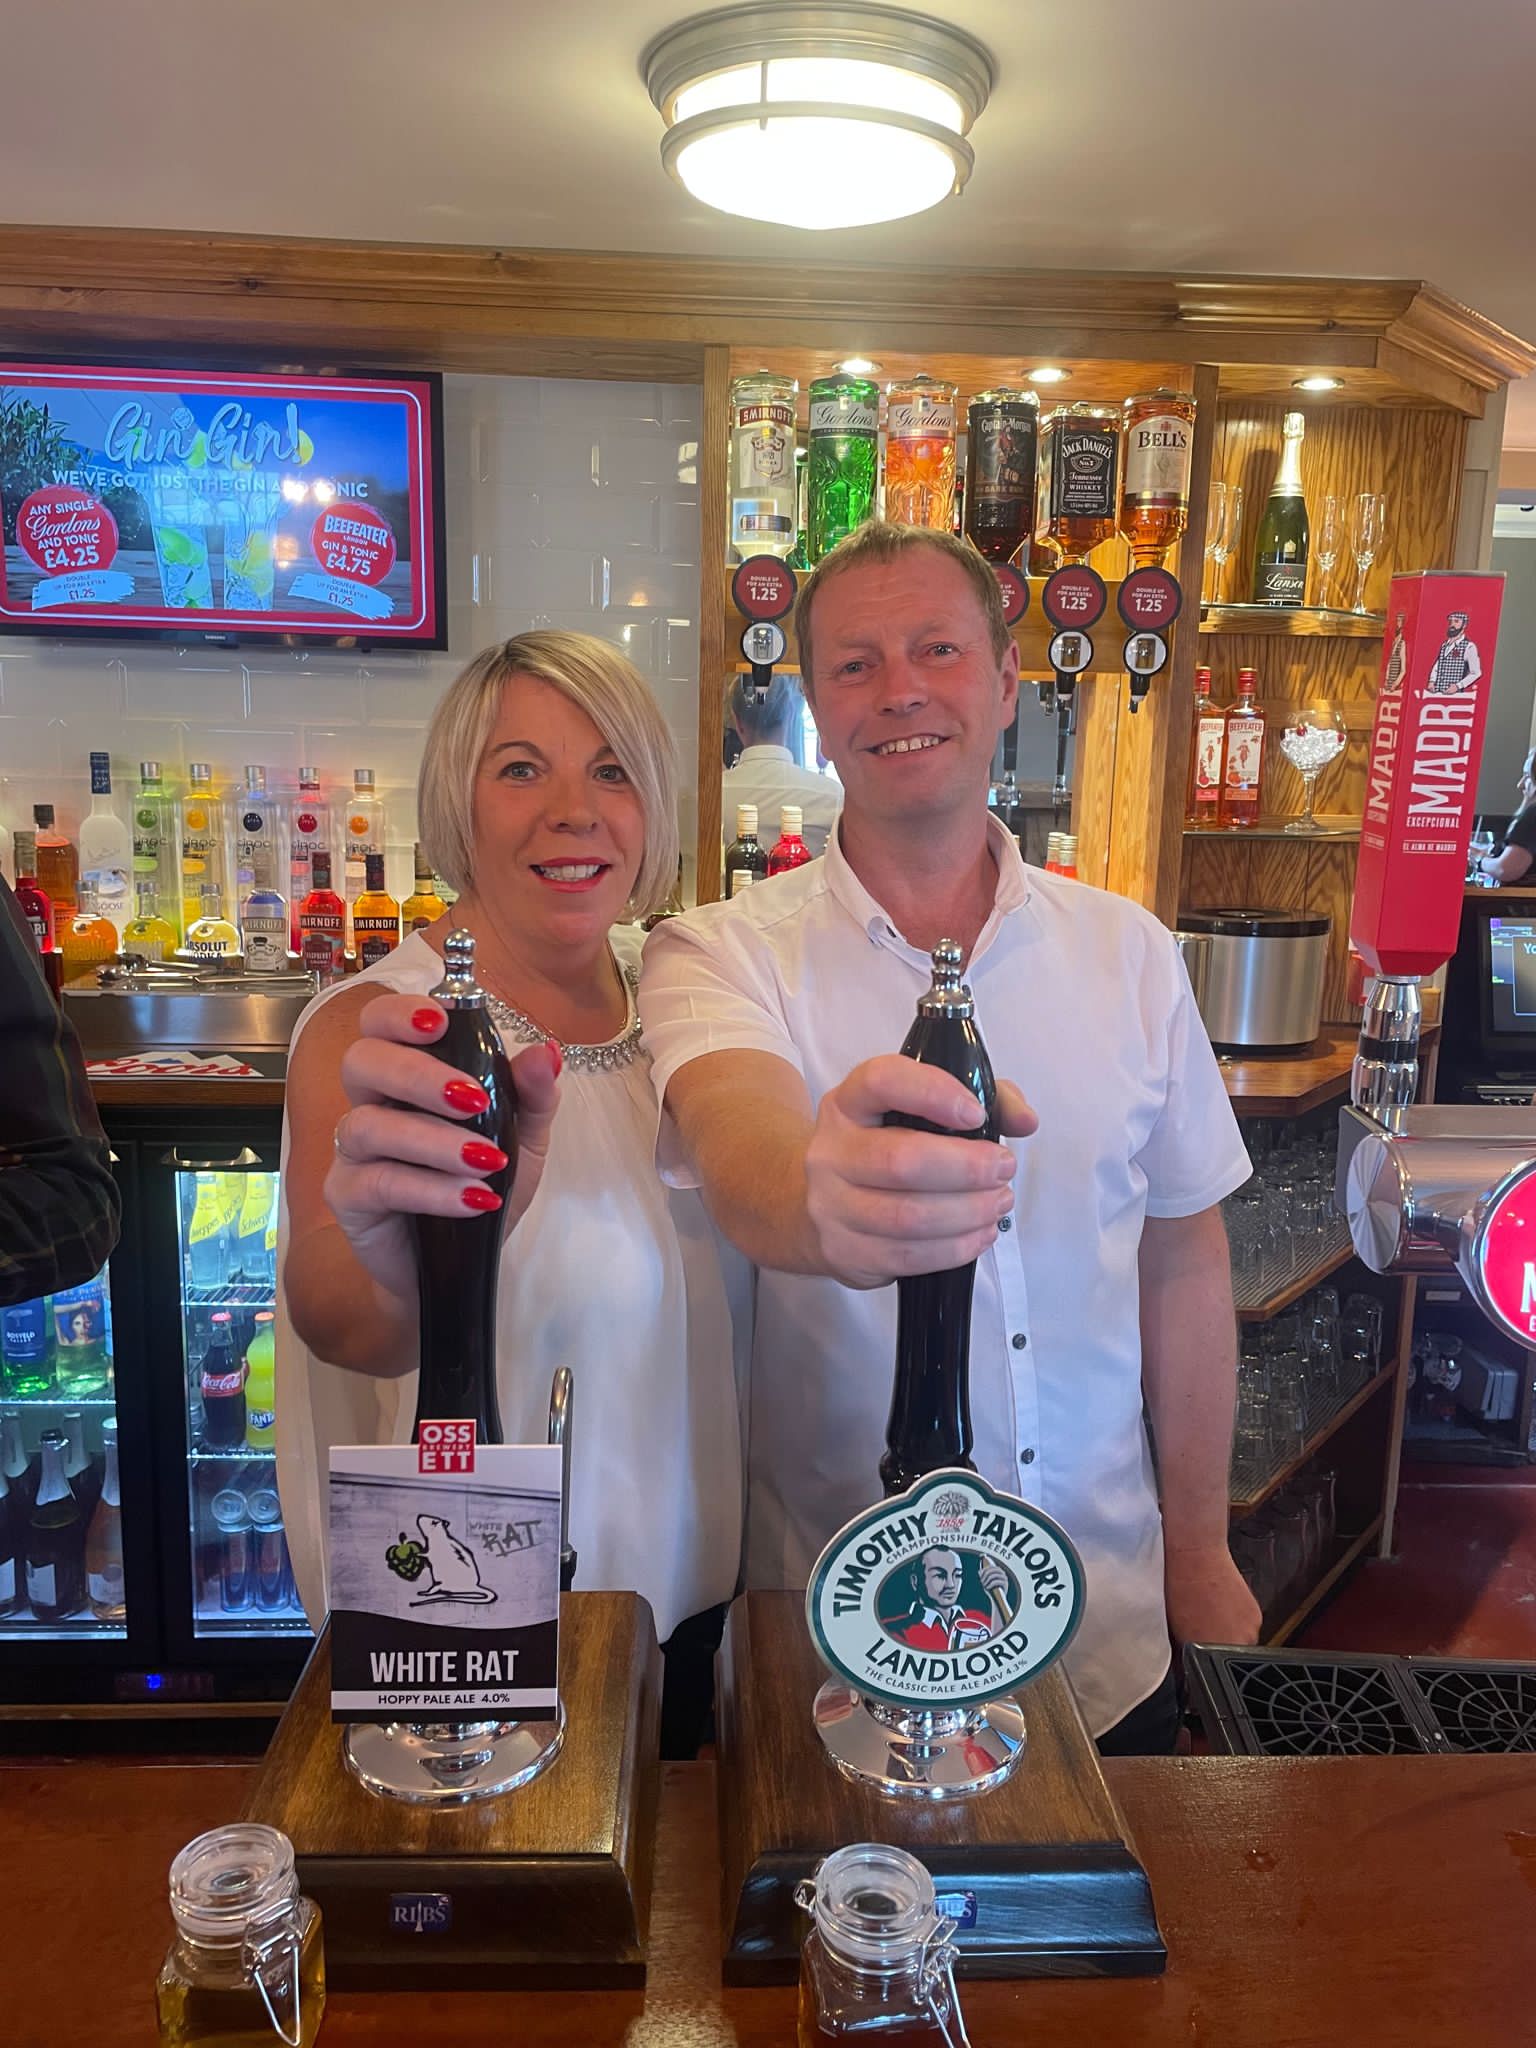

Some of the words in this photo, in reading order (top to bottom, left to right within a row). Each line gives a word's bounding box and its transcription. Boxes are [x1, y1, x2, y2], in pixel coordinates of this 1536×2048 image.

[743, 407, 791, 424] SMIRNOFF
[981, 417, 1007, 432] Captain
[1009, 417, 1031, 433] Morgan
[104, 402, 196, 470] Gin
[207, 402, 299, 470] Gin!
[1138, 431, 1187, 449] BELL'S
[1063, 441, 1082, 457] JACK
[53, 470, 108, 487] WE'VE
[112, 472, 146, 489] GOT
[153, 474, 190, 489] JUST
[198, 476, 230, 492] THE
[234, 478, 265, 493] GIN
[30, 506, 51, 516] ANY
[56, 500, 94, 513] SINGLE
[324, 514, 388, 548] BEEFEATER
[38, 538, 62, 550] AND
[64, 533, 100, 546] TONIC
[322, 540, 340, 551] GIN
[342, 544, 349, 554] &
[350, 545, 379, 561] TONIC
[44, 546, 100, 569] £4.25
[326, 552, 371, 576] £4.75
[68, 587, 96, 600] £1.25
[751, 587, 778, 601] 1.25
[1060, 597, 1088, 610] 1.25
[1135, 599, 1162, 612] 1.25
[1229, 722, 1262, 732] BEEFEATER
[1406, 816, 1460, 828] EXCEPCIONAL
[423, 1425, 471, 1444] OSS
[422, 1451, 471, 1470] ETT
[482, 1520, 542, 1555] RAT
[886, 1533, 977, 1565] CHAMPIONSHIP
[981, 1538, 1015, 1561] BEERS
[833, 1511, 929, 1617] TIMOTHY
[972, 1509, 1066, 1608] TAYLOR'S
[865, 1630, 1029, 1683] LANDLORD
[370, 1651, 457, 1683] WHITE
[466, 1650, 519, 1682] RAT
[865, 1666, 882, 1681] THE
[885, 1676, 928, 1694] CLASSIC
[930, 1685, 956, 1694] PALE
[961, 1681, 979, 1692] ALE
[983, 1673, 1004, 1686] ABV
[1006, 1658, 1028, 1675] 4.3%
[378, 1694, 419, 1705] HOPPY
[423, 1694, 450, 1704] PALE
[454, 1694, 475, 1704] ALE
[482, 1693, 511, 1703] 4.0%
